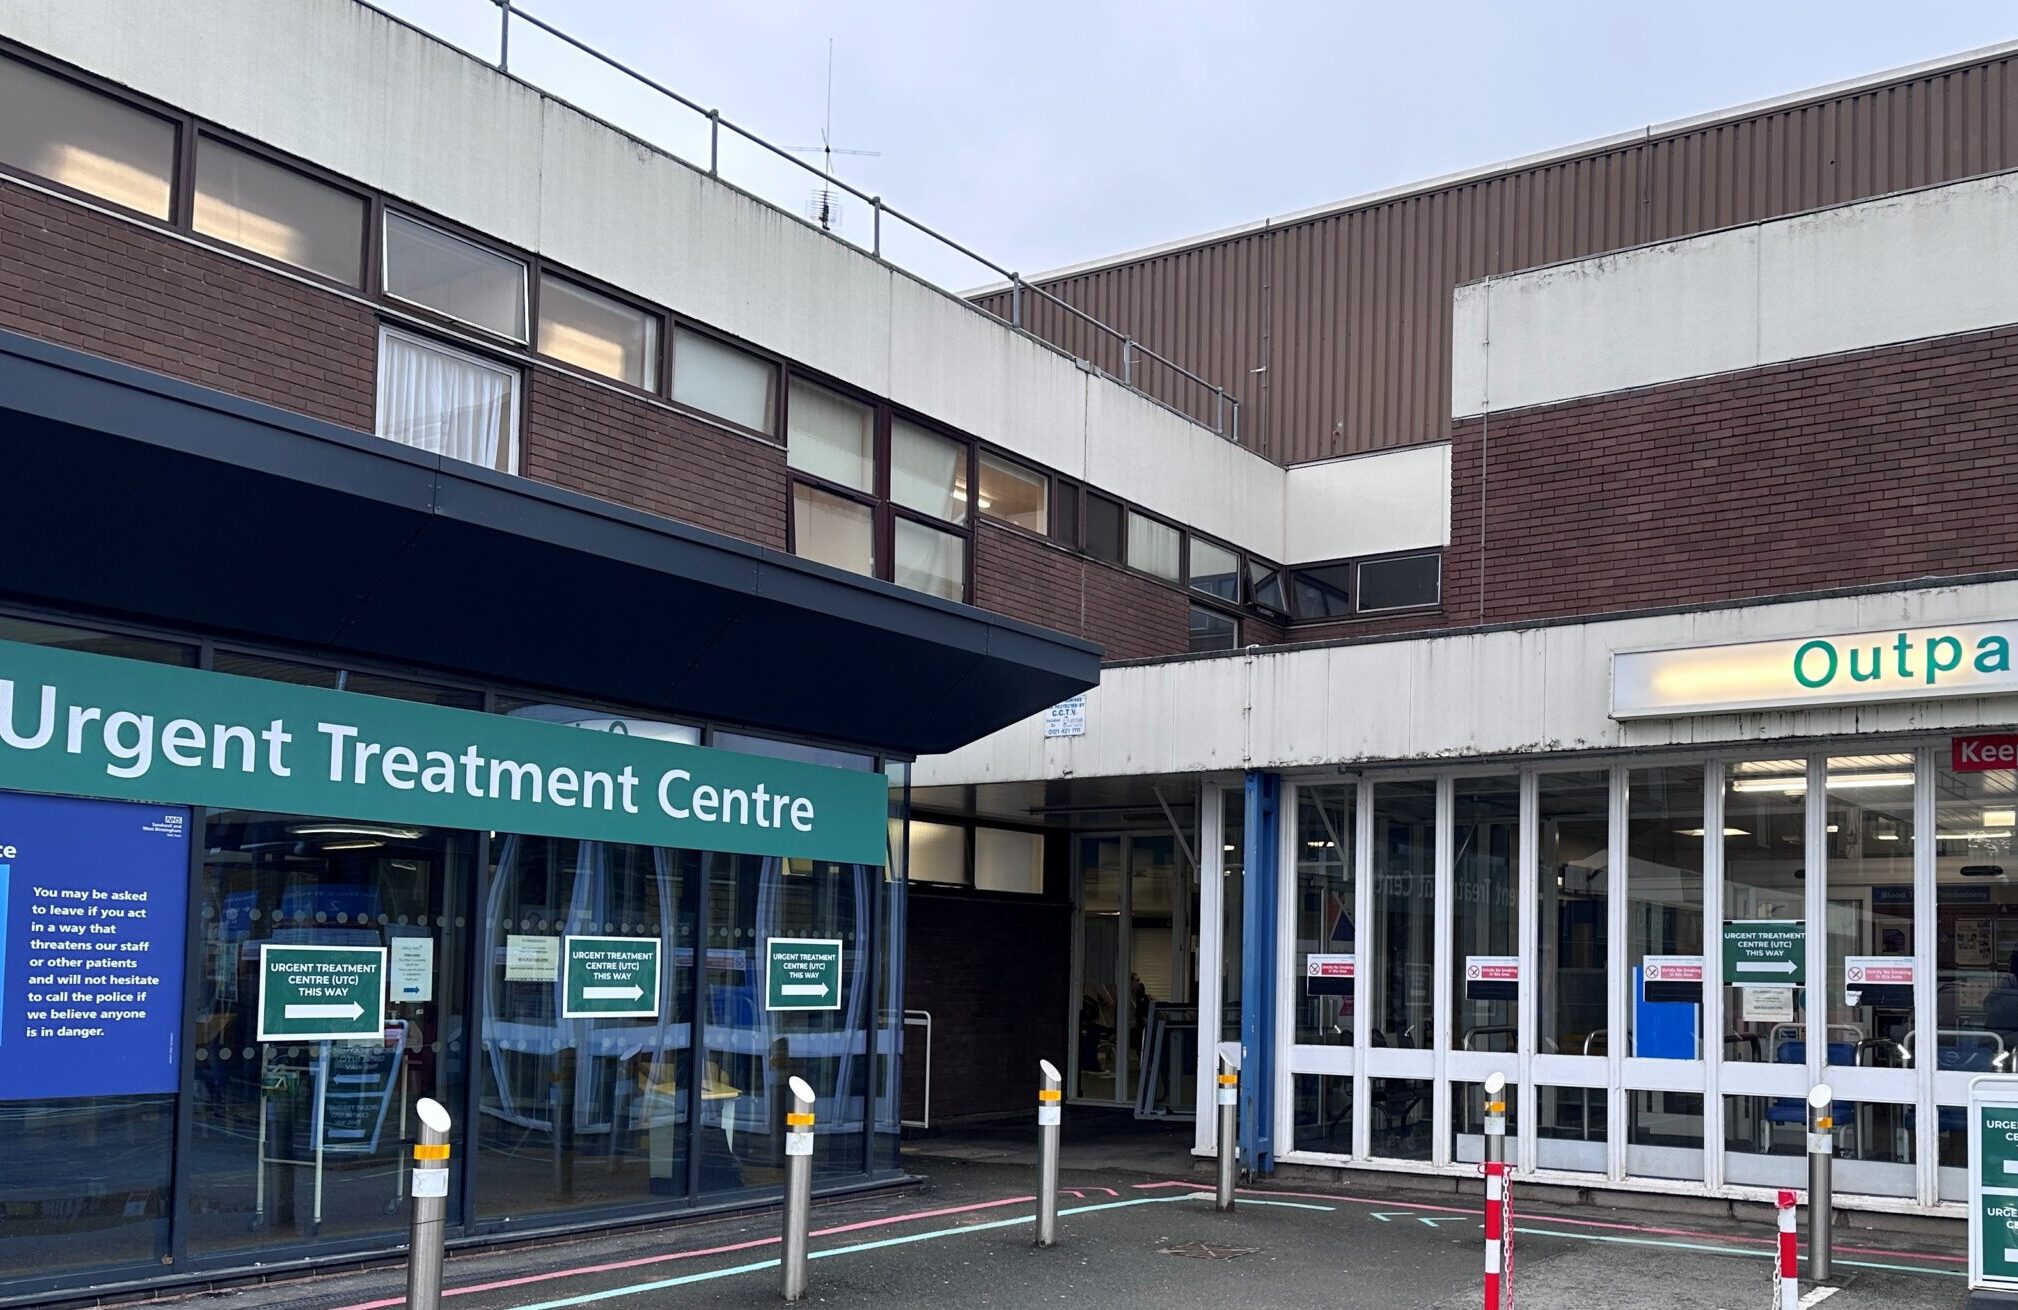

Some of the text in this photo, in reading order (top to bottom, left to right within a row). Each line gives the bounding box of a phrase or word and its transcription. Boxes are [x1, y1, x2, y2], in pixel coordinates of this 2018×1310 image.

[0, 678, 815, 832] Urgent Treatment Centre
[1962, 741, 2018, 767] Kee
[33, 887, 147, 901] You may be asked
[32, 905, 146, 919] to leave if you act
[32, 922, 116, 935] in a way that
[31, 940, 149, 951] threatens our staff
[607, 952, 653, 960] TREATMENT
[30, 958, 137, 970] or other patients
[271, 963, 376, 973] URGENT TREATMENT
[619, 962, 639, 971] (UTC)
[29, 975, 159, 985] and will not hesitate
[288, 975, 359, 985] CENTRE (UTC)
[299, 988, 348, 996] THIS WAY
[28, 992, 147, 1004] to call the police if
[27, 1009, 146, 1021] we believe anyone
[27, 1027, 104, 1038] is in danger.
